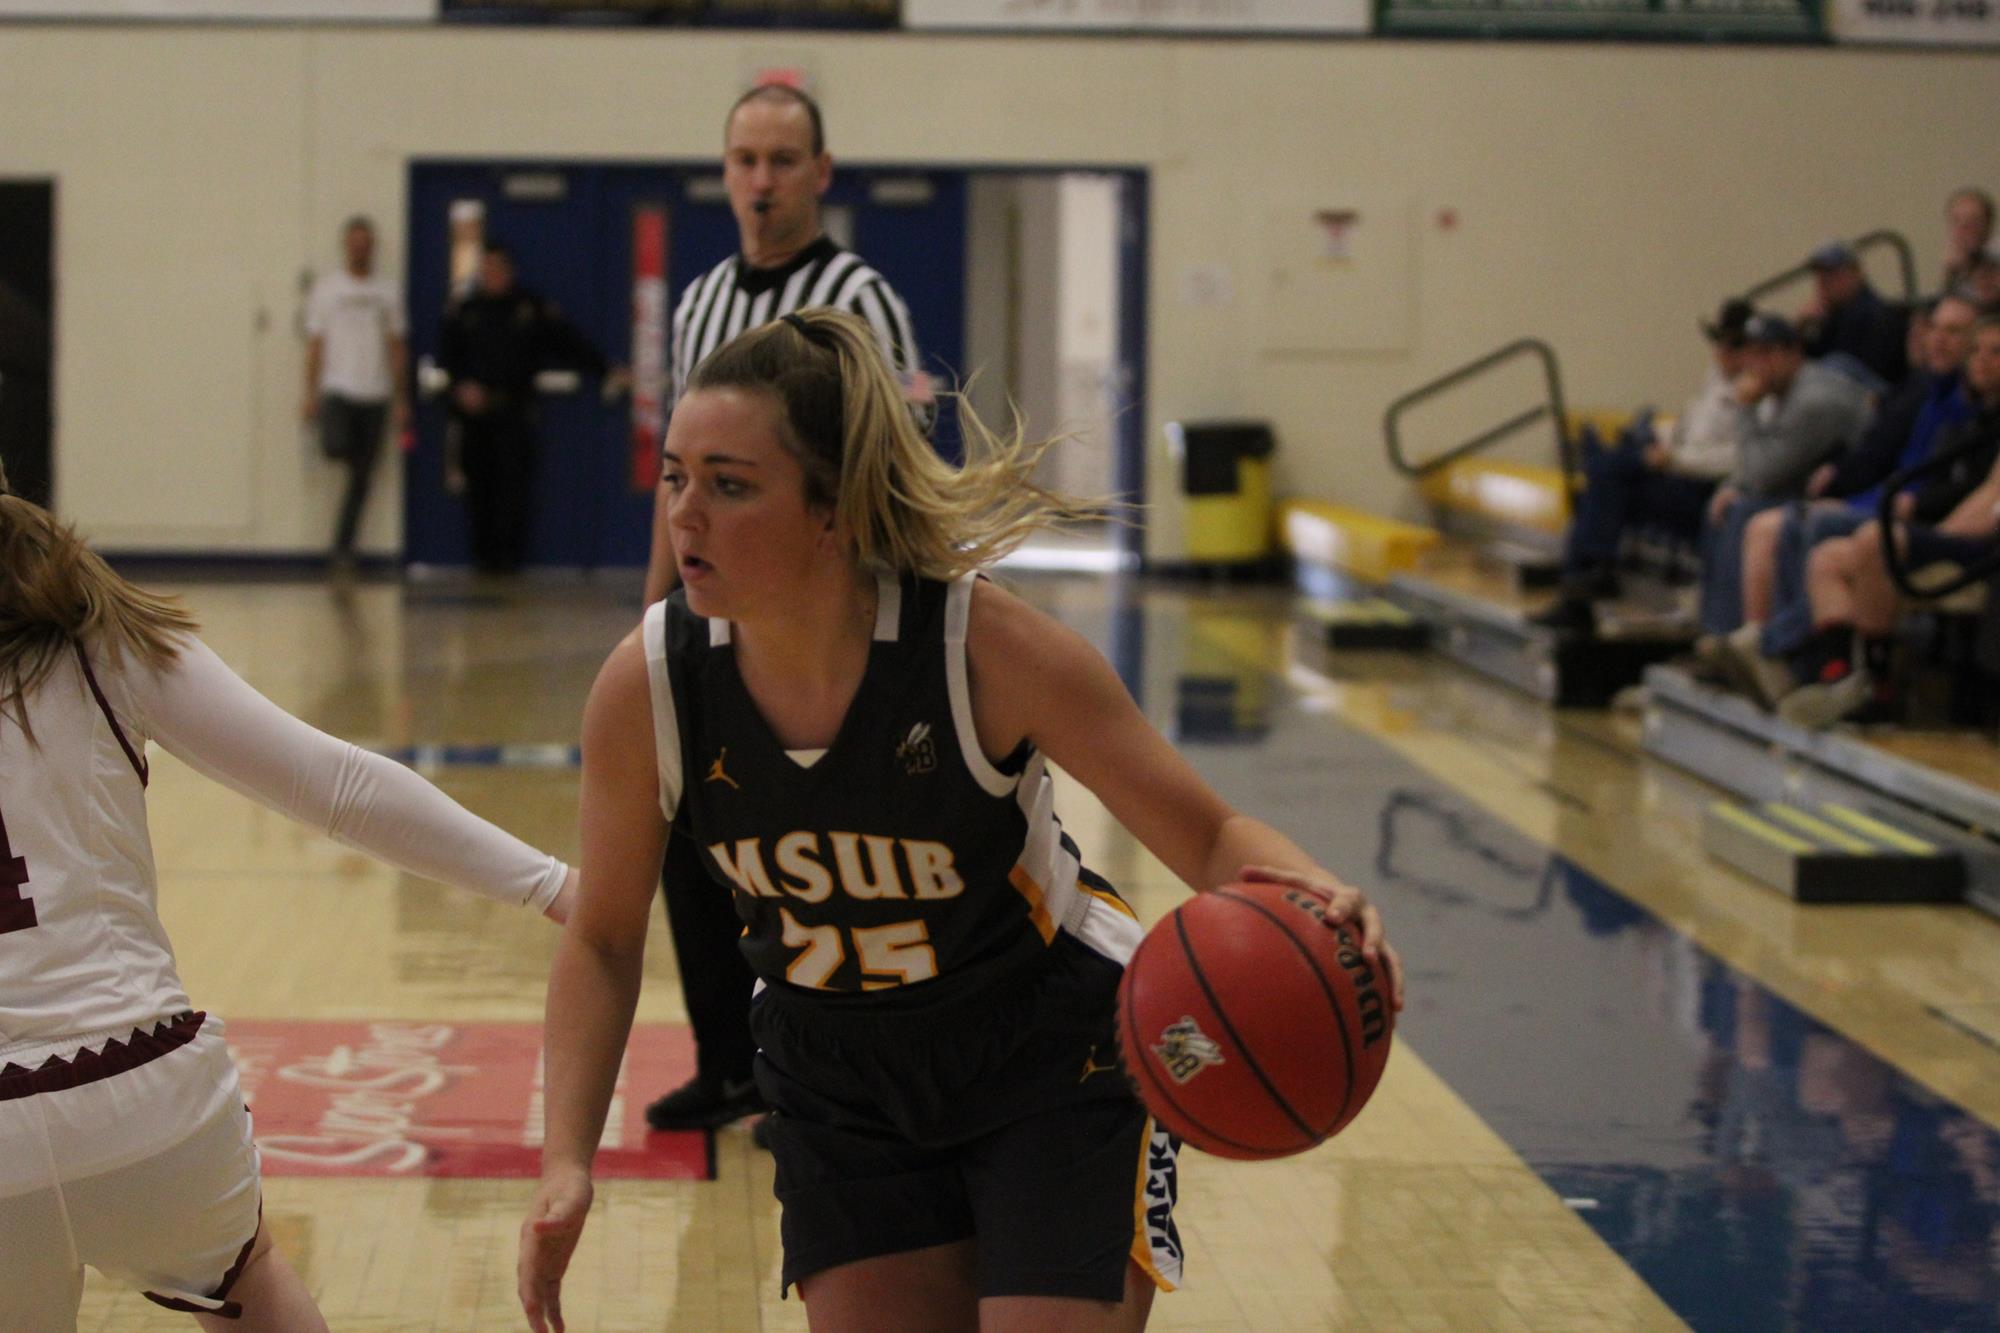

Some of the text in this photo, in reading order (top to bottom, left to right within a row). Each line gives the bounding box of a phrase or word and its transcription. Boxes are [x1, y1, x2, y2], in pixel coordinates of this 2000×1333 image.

[708, 831, 966, 904] MSUB
[779, 906, 939, 993] 25
[1284, 890, 1387, 1050] Wilsn
